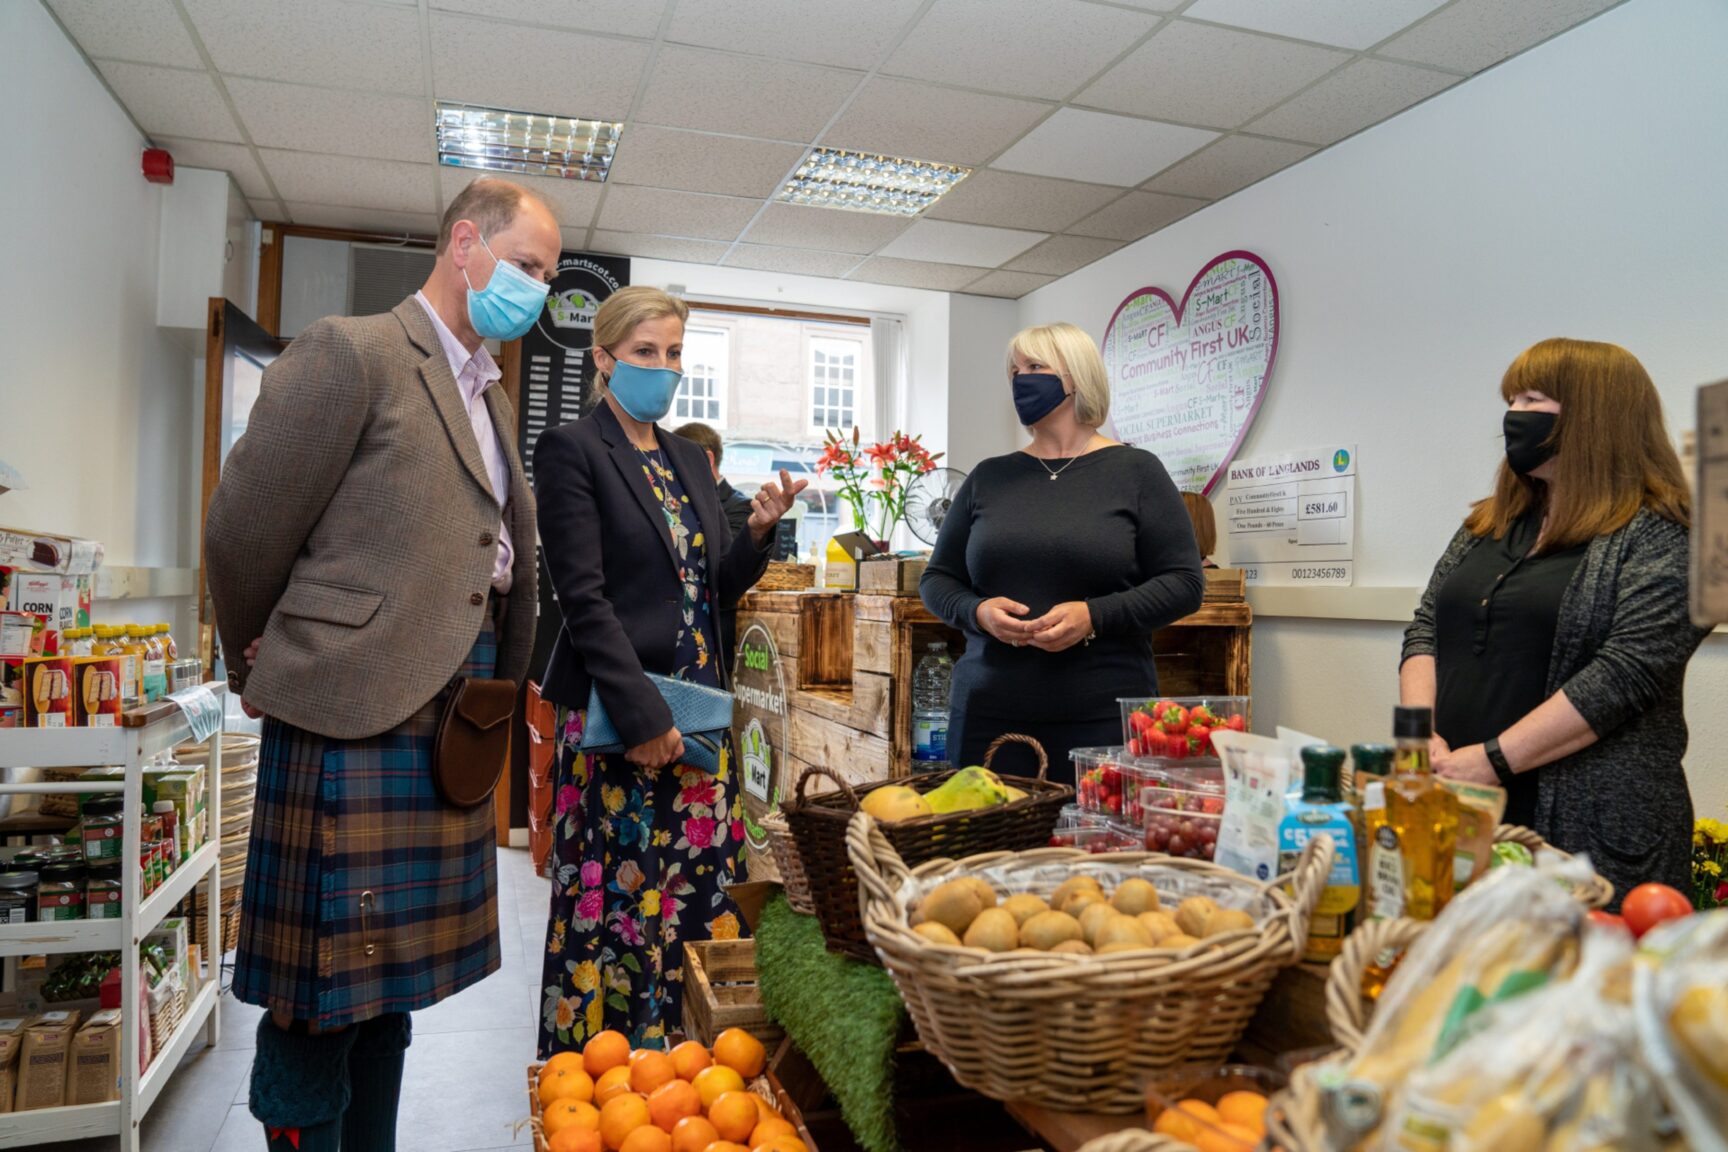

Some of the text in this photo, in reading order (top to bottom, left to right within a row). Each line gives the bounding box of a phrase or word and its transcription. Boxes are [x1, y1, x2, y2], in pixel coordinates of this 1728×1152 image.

[1196, 289, 1228, 311] S-Mart
[1248, 270, 1262, 342] Social
[557, 311, 594, 323] S-Mar
[1223, 313, 1237, 329] CF
[1148, 323, 1165, 348] CF
[1192, 319, 1222, 338] ANGUS
[1121, 346, 1187, 380] Community
[1191, 332, 1223, 360] First
[1227, 325, 1249, 349] UK
[1188, 397, 1199, 410] CF
[1234, 385, 1244, 410] CF
[1146, 406, 1213, 431] SUPERMARKET
[1144, 429, 1172, 443] Business
[1173, 419, 1219, 438] Connections
[1231, 460, 1320, 480] BANK OF LANGLANDS
[1305, 501, 1338, 515] £581.60
[1291, 567, 1346, 579] 00123456789
[23, 602, 53, 613] CORN
[744, 643, 768, 671] Social
